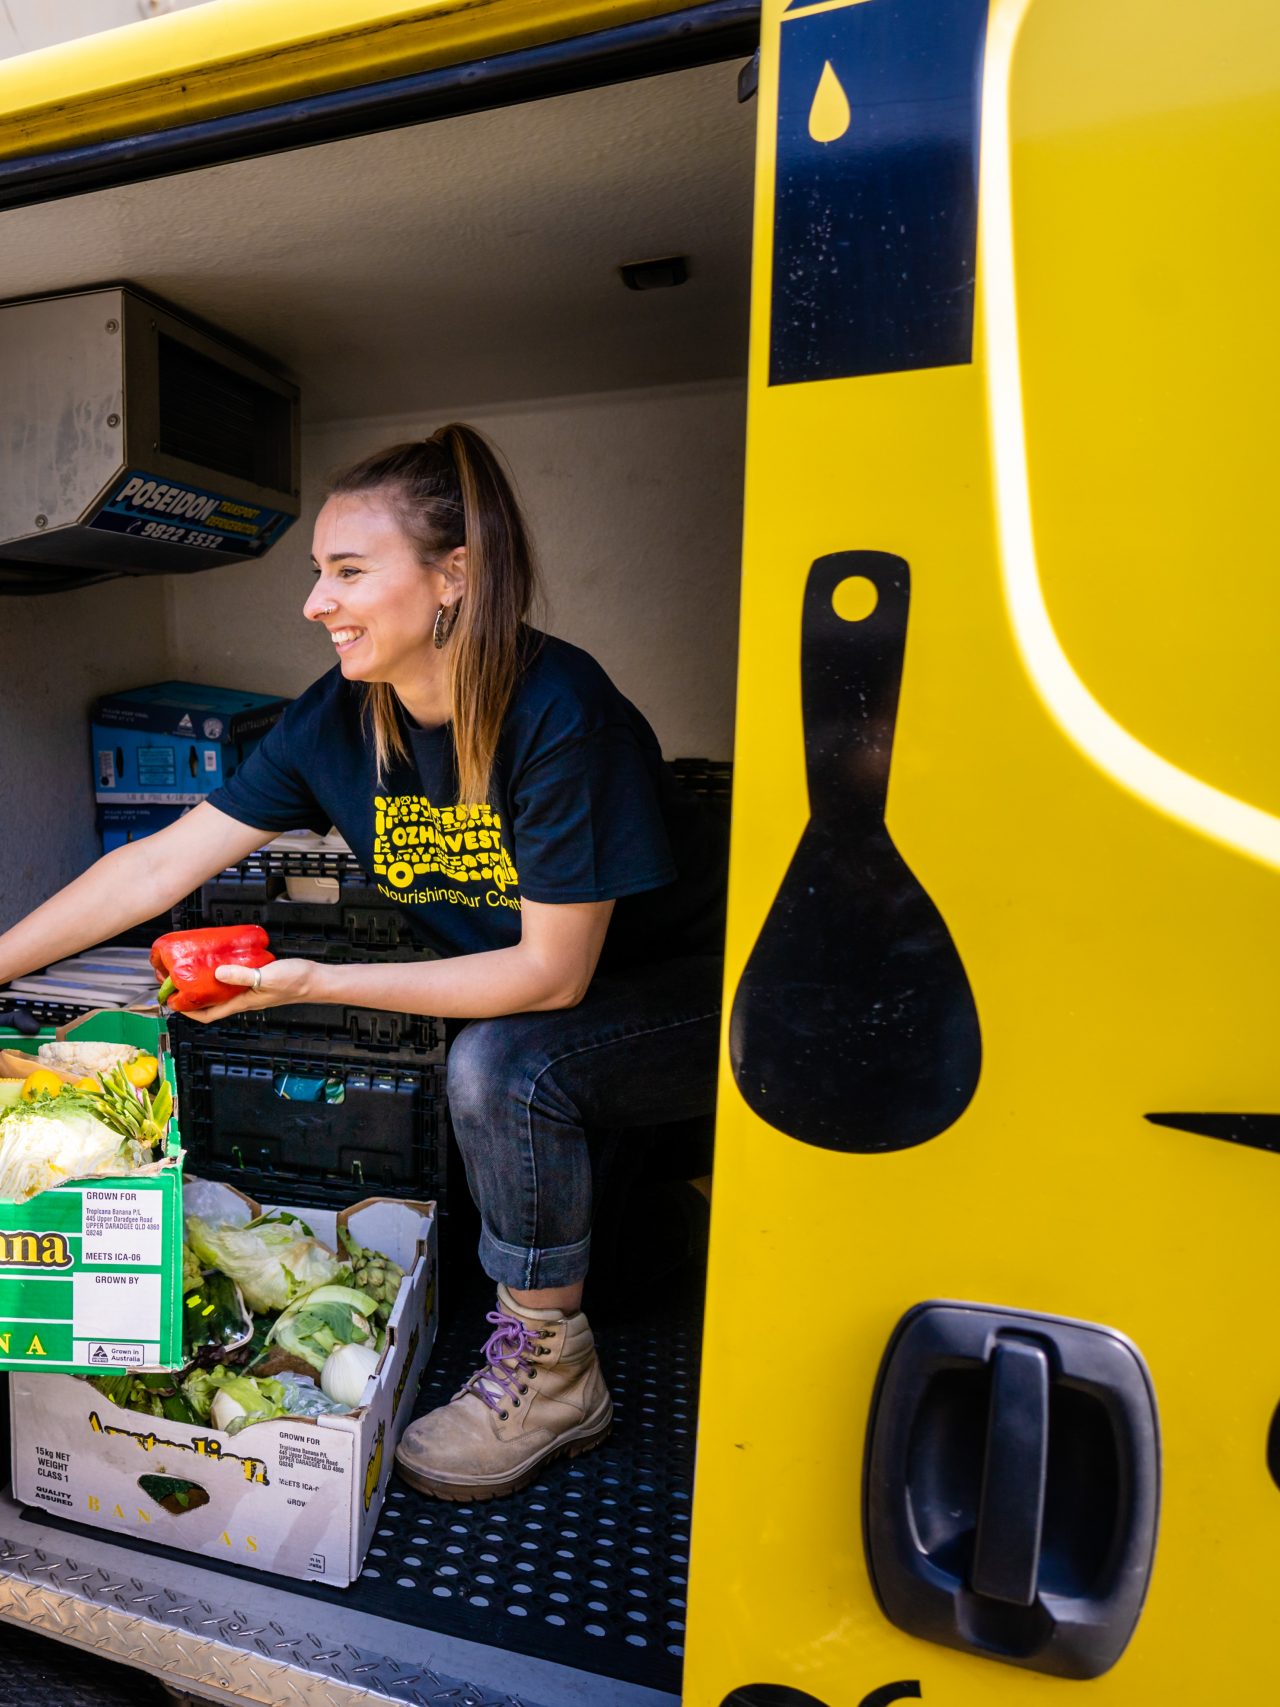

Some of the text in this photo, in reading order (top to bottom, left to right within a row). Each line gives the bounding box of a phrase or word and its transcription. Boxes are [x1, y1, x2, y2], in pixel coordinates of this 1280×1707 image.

[115, 477, 220, 521] POSEIDON
[140, 522, 224, 549] 9822 5532
[377, 883, 522, 911] Nourishing Our Cont
[86, 1191, 137, 1201] GROWN FOR
[97, 1215, 112, 1223] Upper
[112, 1208, 131, 1216] Banana
[85, 1252, 141, 1262] MEETS ICA-06
[95, 1275, 140, 1285] GROWN BY
[279, 1431, 320, 1446] GROWN FOR
[35, 1446, 71, 1462] 15kg NET
[37, 1457, 69, 1472] WEIGHT
[37, 1467, 69, 1483] CLASS 1
[279, 1478, 320, 1492] MEETS ICA-
[36, 1486, 72, 1499] QUALITY
[35, 1493, 73, 1507] ASSURED
[87, 1495, 257, 1552] BANAS
